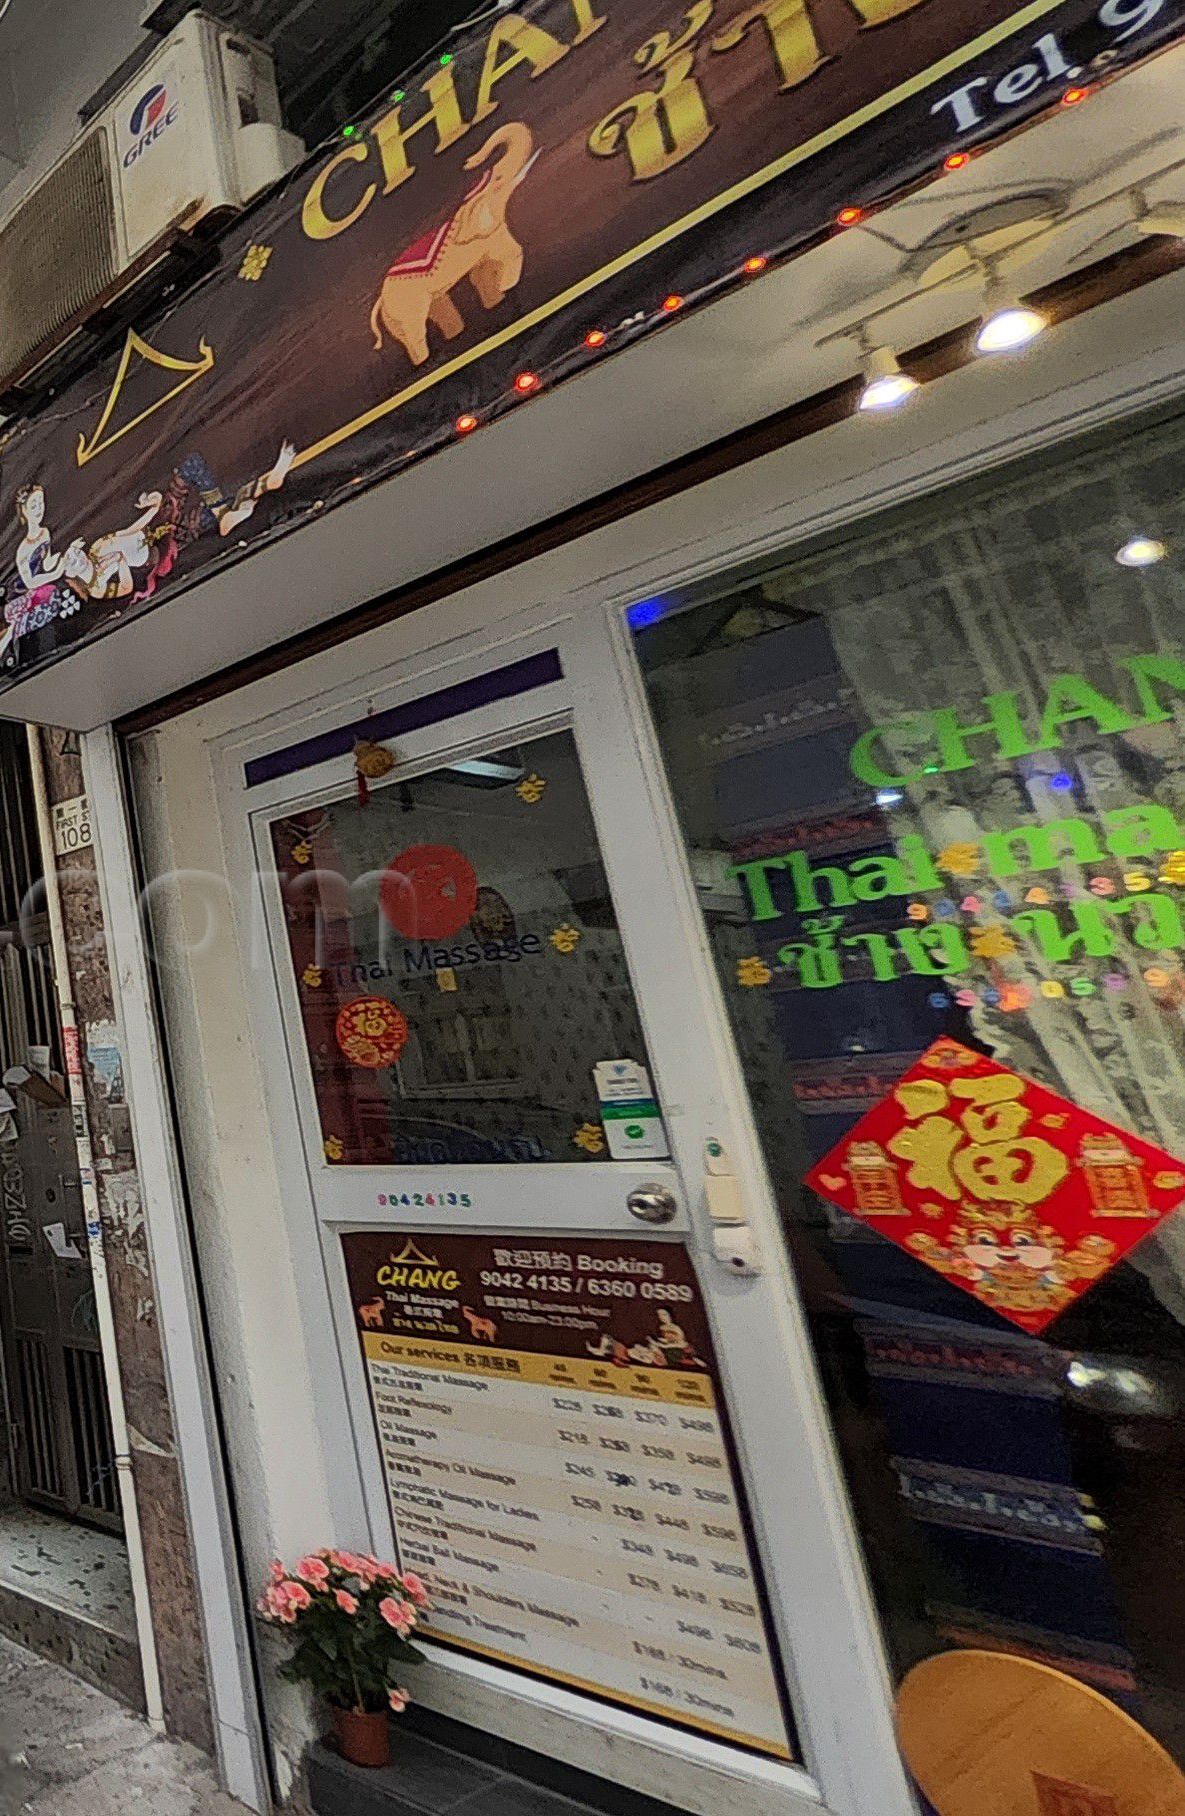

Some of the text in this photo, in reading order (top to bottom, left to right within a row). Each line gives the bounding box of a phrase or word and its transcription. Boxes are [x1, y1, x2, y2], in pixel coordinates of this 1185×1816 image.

[122, 101, 179, 168] GREE
[61, 823, 91, 850] 108
[725, 833, 945, 921] Thai
[404, 933, 542, 973] Massage
[376, 1265, 461, 1290] CHANG
[577, 1254, 664, 1279] Booking
[479, 1270, 523, 1289] 9042
[526, 1274, 573, 1293] 4135
[380, 1341, 403, 1354] Our
[407, 1345, 460, 1363] services
